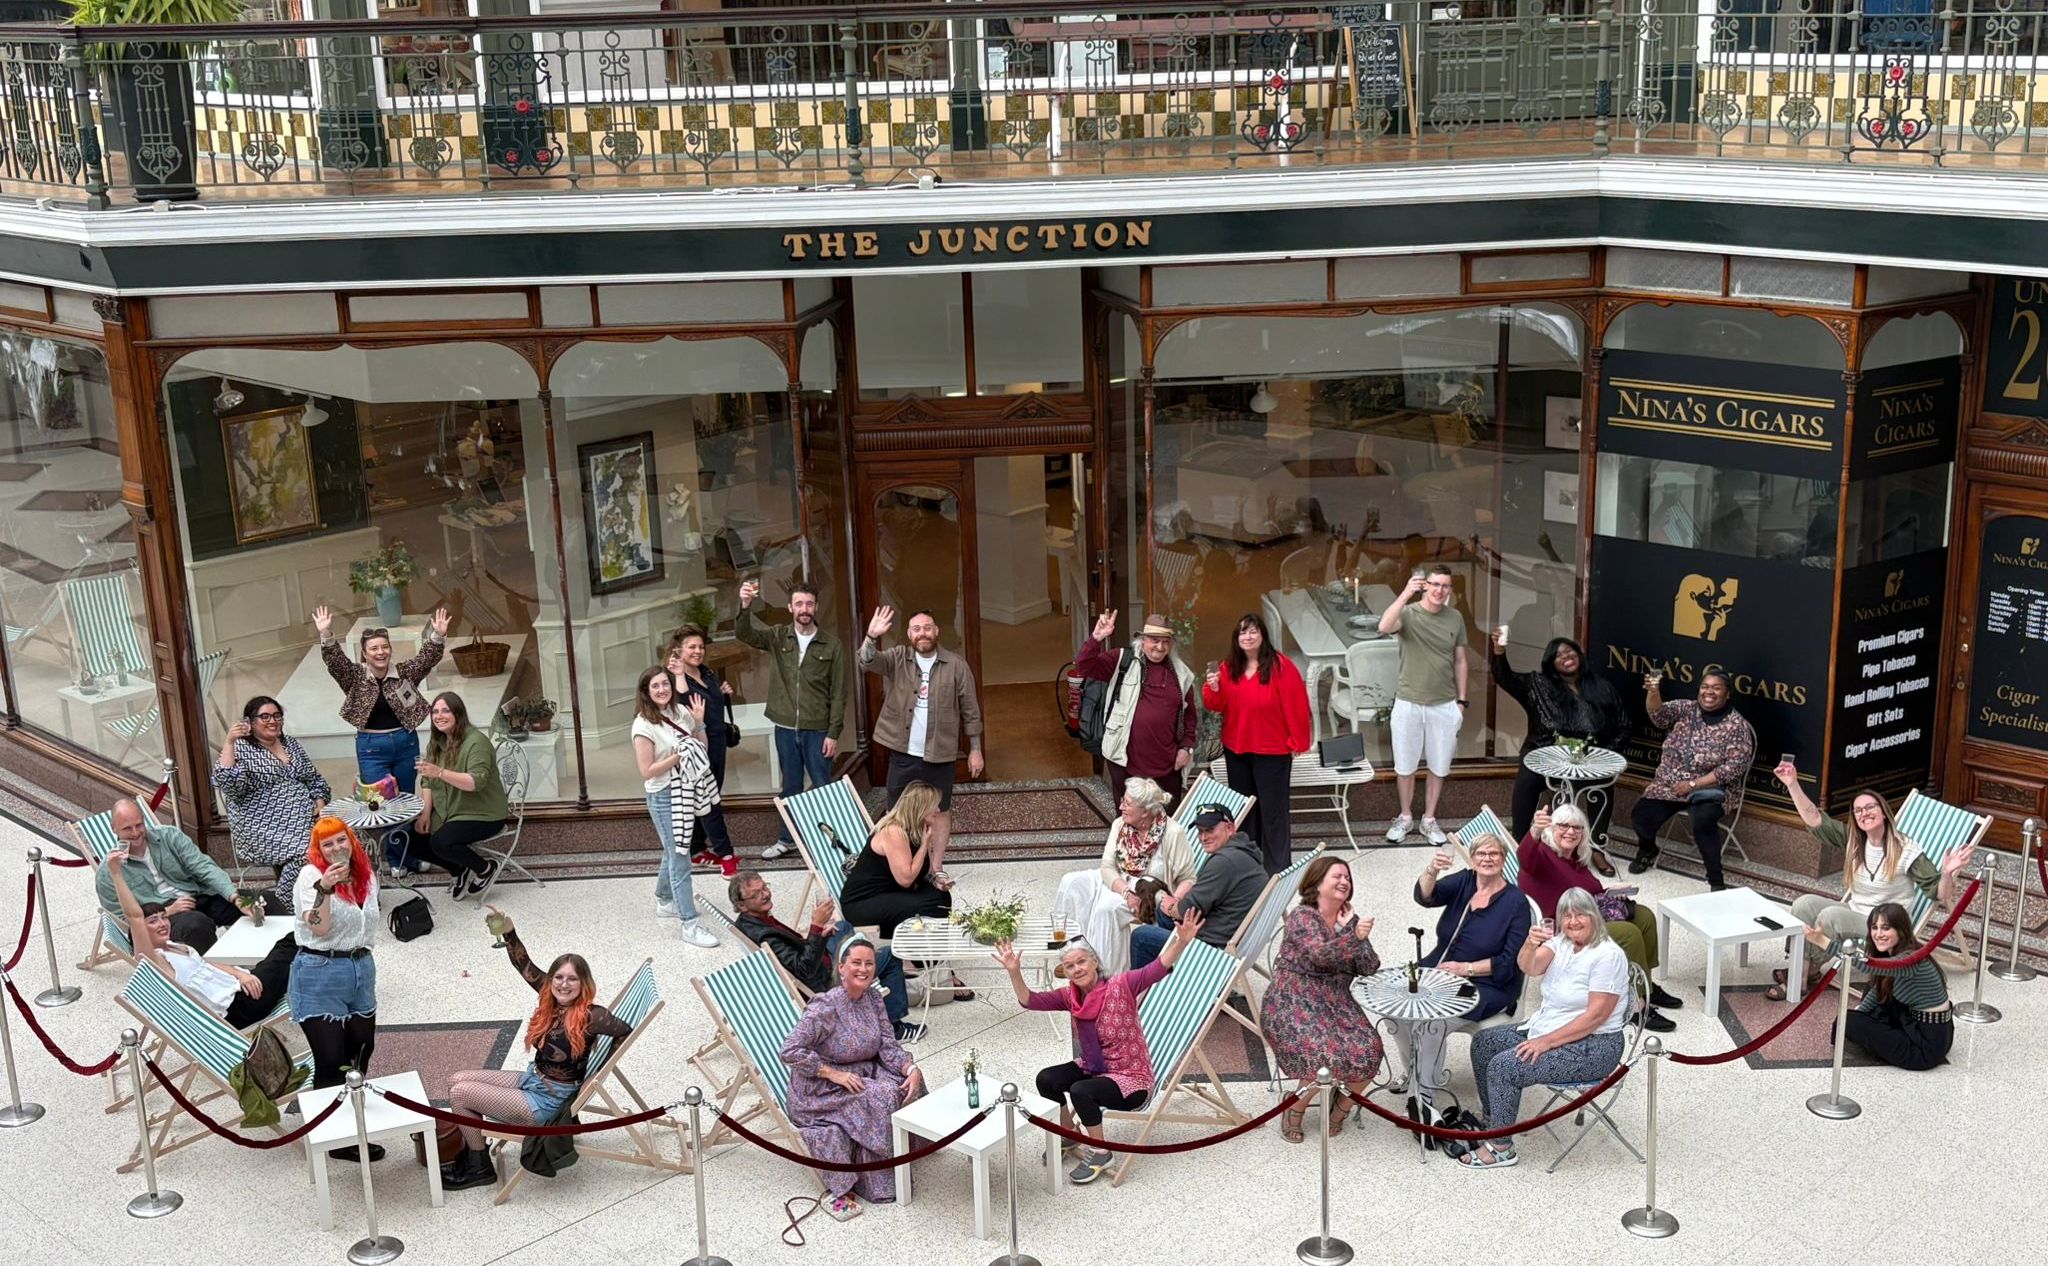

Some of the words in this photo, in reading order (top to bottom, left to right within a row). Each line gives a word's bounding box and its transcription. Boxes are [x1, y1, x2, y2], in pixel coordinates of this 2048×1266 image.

[783, 231, 879, 258] THE
[908, 221, 1152, 255] JUNCTION
[2003, 306, 2048, 401] 2
[1617, 389, 1707, 424] NINA'S
[1716, 400, 1824, 437] CIGARS
[1880, 392, 1934, 420] NINA'S
[1874, 420, 1935, 445] CIGARS
[1990, 591, 2010, 600] Monday
[2007, 585, 2029, 595] Opening
[1857, 634, 1896, 654] Premium
[1897, 627, 1925, 645] Cigars
[1862, 663, 1881, 679] Pipe
[1882, 655, 1917, 673] Tobacco
[1702, 663, 1807, 705] GARS
[1844, 690, 1866, 708] Hand
[1866, 685, 1895, 702] Rolling
[1896, 676, 1930, 695] Tobacco
[1996, 684, 2040, 707] Cigar
[1866, 711, 1883, 727] Gift
[1884, 707, 1904, 723] Sets
[1845, 742, 1868, 759] Cigar
[1869, 728, 1921, 752] Accessories
